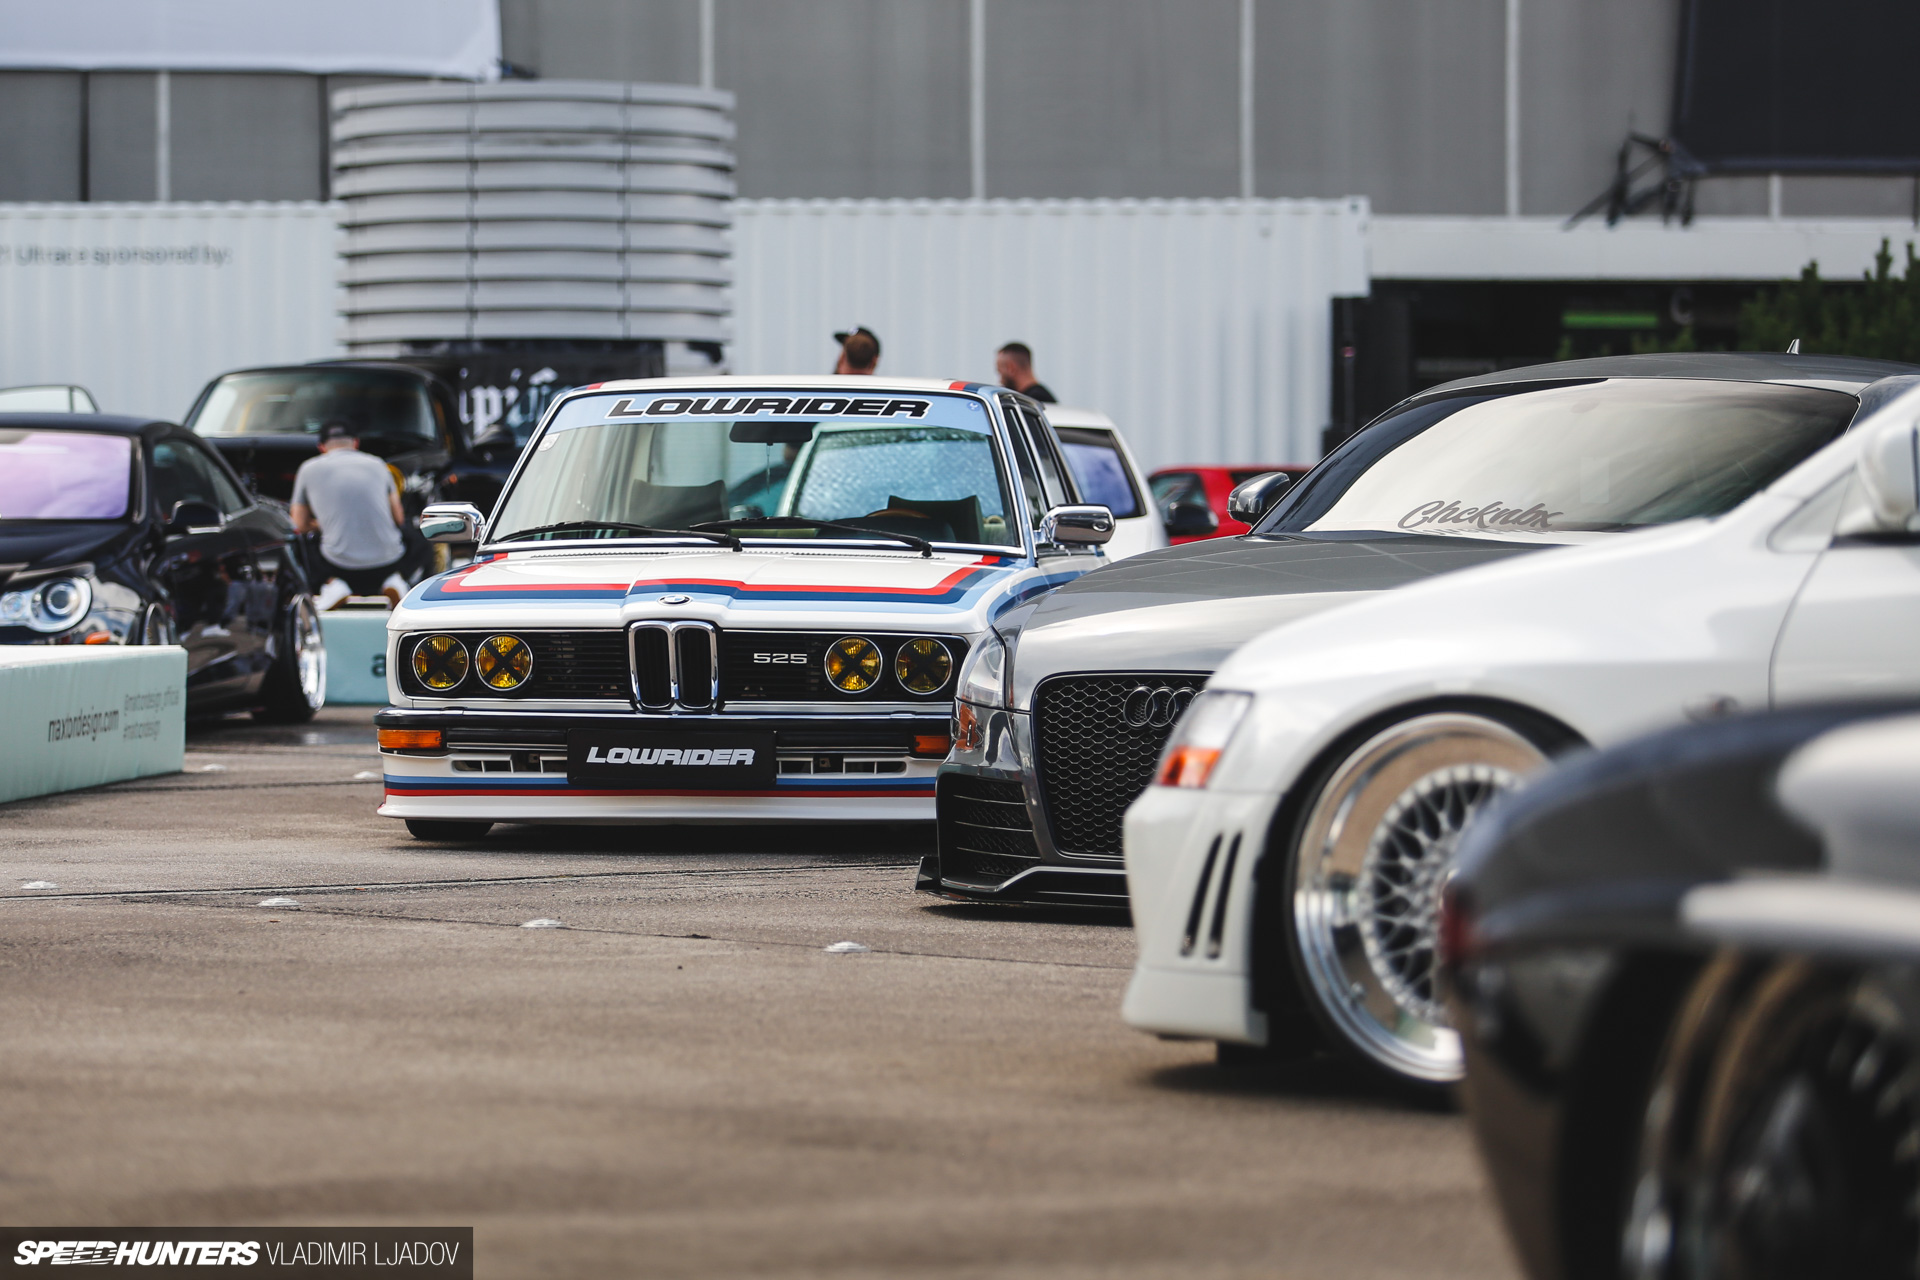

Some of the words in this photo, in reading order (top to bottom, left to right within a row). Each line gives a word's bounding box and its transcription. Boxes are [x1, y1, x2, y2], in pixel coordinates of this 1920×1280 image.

[604, 396, 933, 419] LOWRIDER
[753, 652, 808, 664] 525
[586, 746, 756, 766] LOWRIDER
